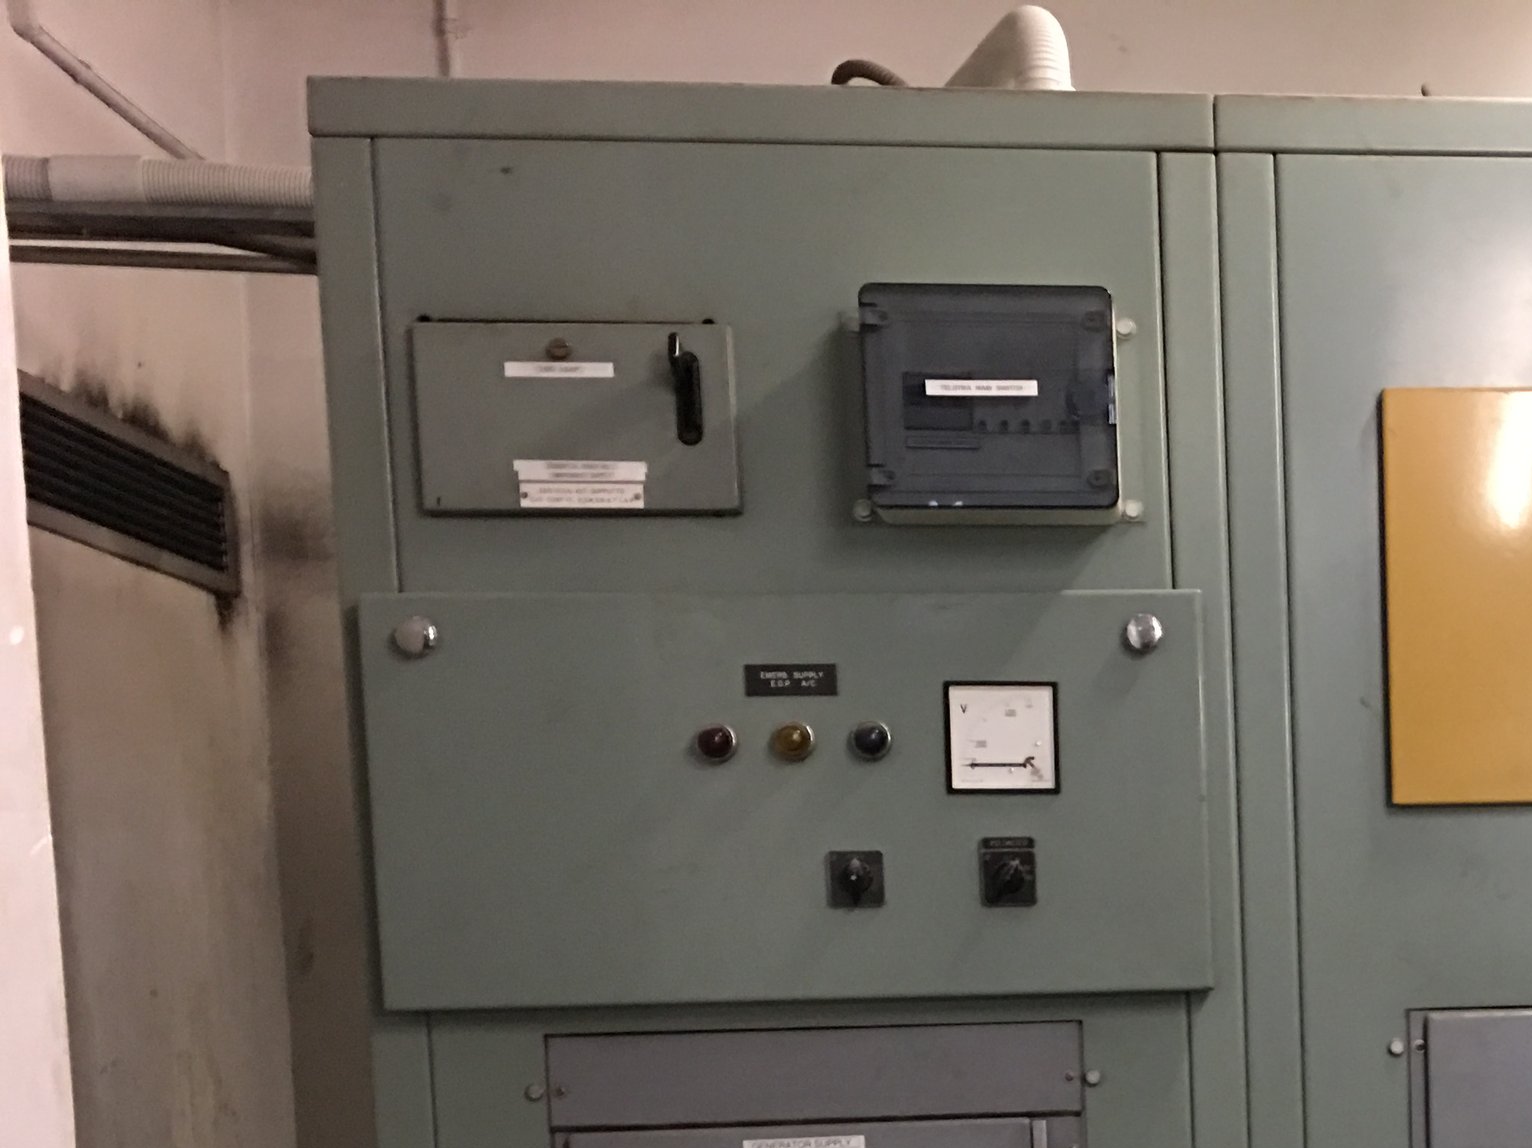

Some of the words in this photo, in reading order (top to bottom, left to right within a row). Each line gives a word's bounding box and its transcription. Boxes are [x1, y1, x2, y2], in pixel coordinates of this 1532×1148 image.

[793, 671, 823, 679] SUPPLY
[960, 704, 967, 714] V
[814, 1137, 851, 1148] SUPPLY
